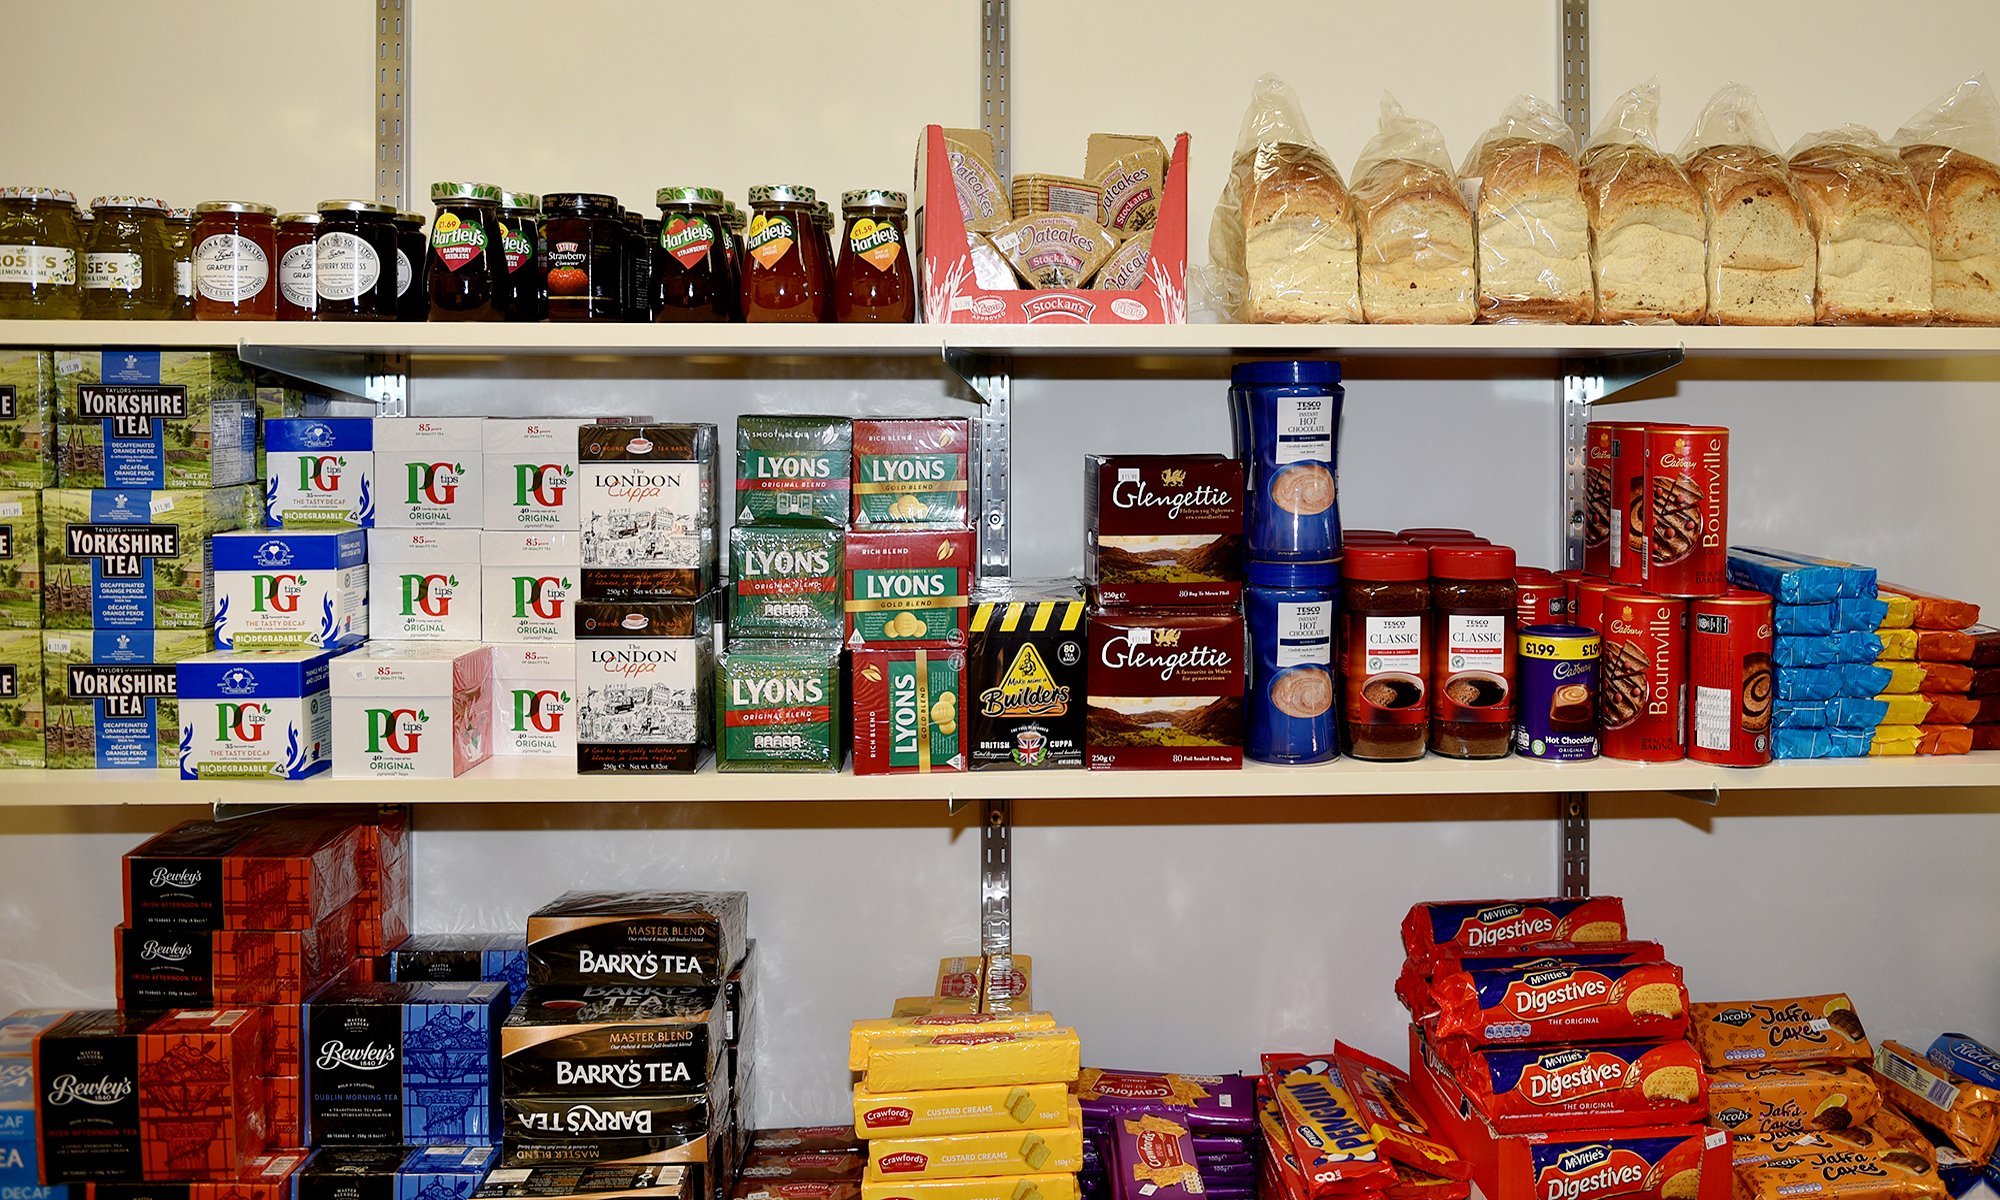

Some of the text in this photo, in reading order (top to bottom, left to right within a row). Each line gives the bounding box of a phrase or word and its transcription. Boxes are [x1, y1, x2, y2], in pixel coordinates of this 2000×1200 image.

[1116, 190, 1149, 225] Stockan's
[439, 220, 457, 229] £1.69
[854, 224, 873, 236] £1.59
[432, 229, 485, 246] Hartley's
[663, 225, 713, 247] Hartley's
[850, 227, 899, 252] Hartley's
[1013, 224, 1094, 258] Oatcakes
[549, 251, 587, 262] Strawberry
[676, 246, 708, 257] STRAWBERRY
[1033, 252, 1078, 267] Stockan's
[1033, 298, 1085, 314] Stockan's
[82, 391, 183, 414] YORKSHIRE
[115, 416, 150, 434] TEA
[1287, 425, 1325, 433] CHOCOLATE
[1299, 417, 1318, 425] HOT
[758, 457, 830, 479] LYONS
[1660, 453, 1697, 470] Cadbury
[298, 456, 341, 492] PG tips
[872, 460, 945, 481] LYONS
[595, 475, 681, 487] LONDON
[607, 480, 661, 503] Cuppa
[1112, 480, 1232, 519] Glengettie
[1702, 438, 1722, 548] Bournville
[284, 512, 343, 520] BIODEGRADABLE
[409, 511, 451, 520] ORIGINAL
[517, 514, 560, 522] ORIGINAL
[70, 530, 174, 554] YORKSHIRE
[105, 556, 140, 574] TEA
[745, 550, 829, 575] LYONS
[867, 575, 945, 598] LYONS
[1103, 591, 1119, 600] 250g
[403, 623, 445, 632] ORIGINAL
[1289, 629, 1324, 637] CHOCOLATE
[1299, 622, 1318, 630] HOT
[1610, 620, 1643, 637] Cadbury
[235, 634, 303, 643] BIODEGRADABLE
[1370, 634, 1418, 643] CLASSIC
[1453, 632, 1501, 643] CLASSIC
[591, 650, 677, 663] LONDON
[1063, 644, 1075, 653] 80
[604, 656, 657, 678] Cuppa
[1102, 636, 1232, 681] Glengettie
[1649, 607, 1671, 715] Bournville
[1553, 661, 1592, 680] Cadbury
[72, 671, 177, 694] YORKSHIRE
[733, 678, 823, 705] LYONS
[107, 696, 143, 715] TEA
[980, 685, 1070, 716] Builders
[895, 674, 917, 753] LYONS
[980, 740, 1073, 749] BRITISH CUPPA
[1545, 736, 1594, 744] Hot Chocolate
[370, 762, 415, 770] ORIGINAL
[1091, 754, 1108, 763] 250g
[200, 765, 268, 773] BIODEGRADABLE
[150, 867, 202, 888] Bewley's
[1483, 906, 1518, 922] McVitie's
[627, 926, 705, 936] MASTER BLEND
[1468, 917, 1553, 947] Digestives
[140, 940, 192, 961] Bewley's
[579, 950, 703, 979] BARRY'S TEA
[1530, 970, 1568, 986] McVitie's
[1515, 979, 1606, 1014] Digestives
[1565, 1017, 1600, 1026] ORIGINAL
[1718, 1010, 1752, 1023] Jacob's
[1752, 1003, 1814, 1025] Jaffa
[610, 1031, 694, 1042] MASTER BLEND
[316, 1040, 395, 1071] Bewley's
[1544, 1052, 1583, 1070] McVitie's
[557, 1059, 691, 1088] BARRY'S TEA
[1530, 1062, 1622, 1098] Digestives
[1978, 1070, 1997, 1084] Classic
[48, 1074, 132, 1106] Bewley's
[926, 1107, 960, 1117] CUSTARD
[962, 1105, 993, 1115] CREAMS
[1579, 1102, 1615, 1110] ORIGINAL
[1759, 1100, 1806, 1118] Jaffa
[518, 1105, 652, 1136] BARRY'S TEA
[866, 1109, 911, 1121] Crawford's
[1285, 1081, 1375, 1151] PENGUIN
[941, 1154, 975, 1163] CUSTARD
[977, 1152, 1008, 1161] CREAMS
[1564, 1150, 1605, 1171] McVitie's
[1810, 1153, 1869, 1166] Jaffa
[1821, 1163, 1887, 1181] Cakes
[1547, 1164, 1643, 1200] Digestives
[2, 1187, 52, 1200] DECAF
